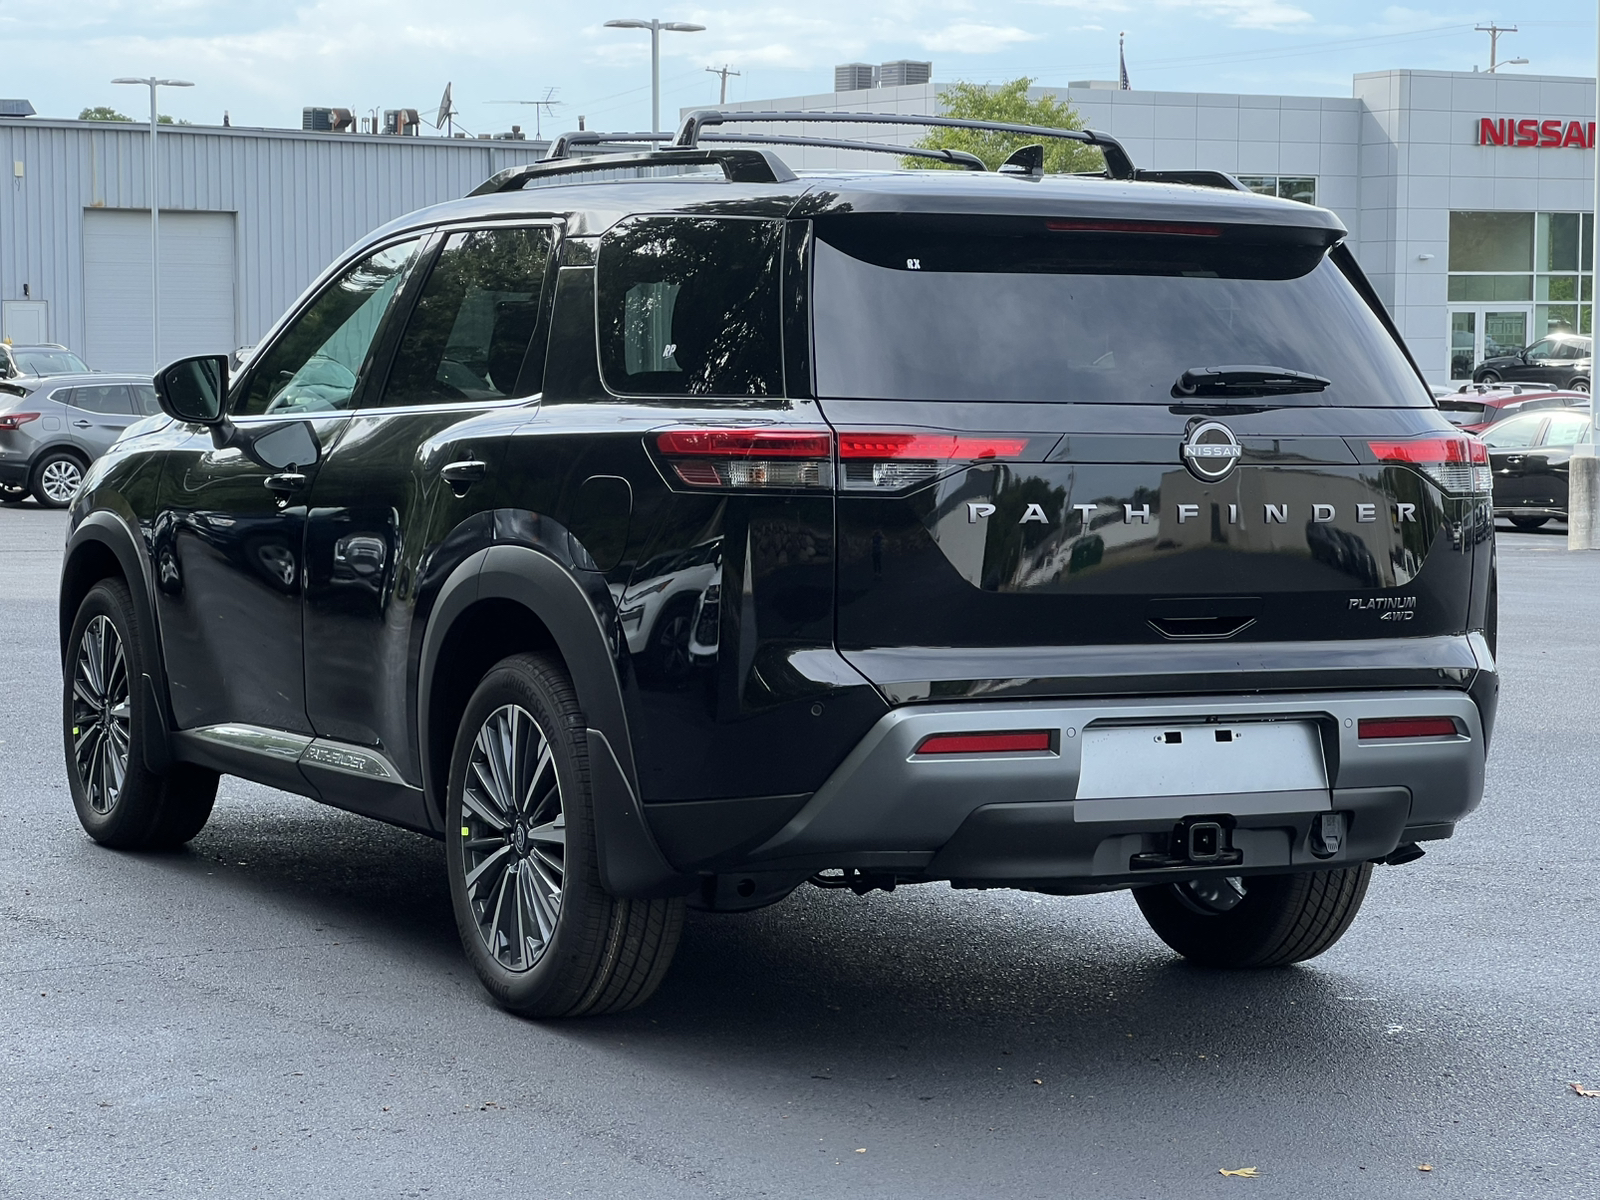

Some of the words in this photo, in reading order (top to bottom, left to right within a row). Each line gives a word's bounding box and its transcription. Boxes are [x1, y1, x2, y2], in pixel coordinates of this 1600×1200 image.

[1186, 447, 1240, 456] NISSAN
[967, 503, 1417, 524] PATHFINDER
[1349, 597, 1416, 609] PLATINUM
[1380, 611, 1414, 621] 4WD
